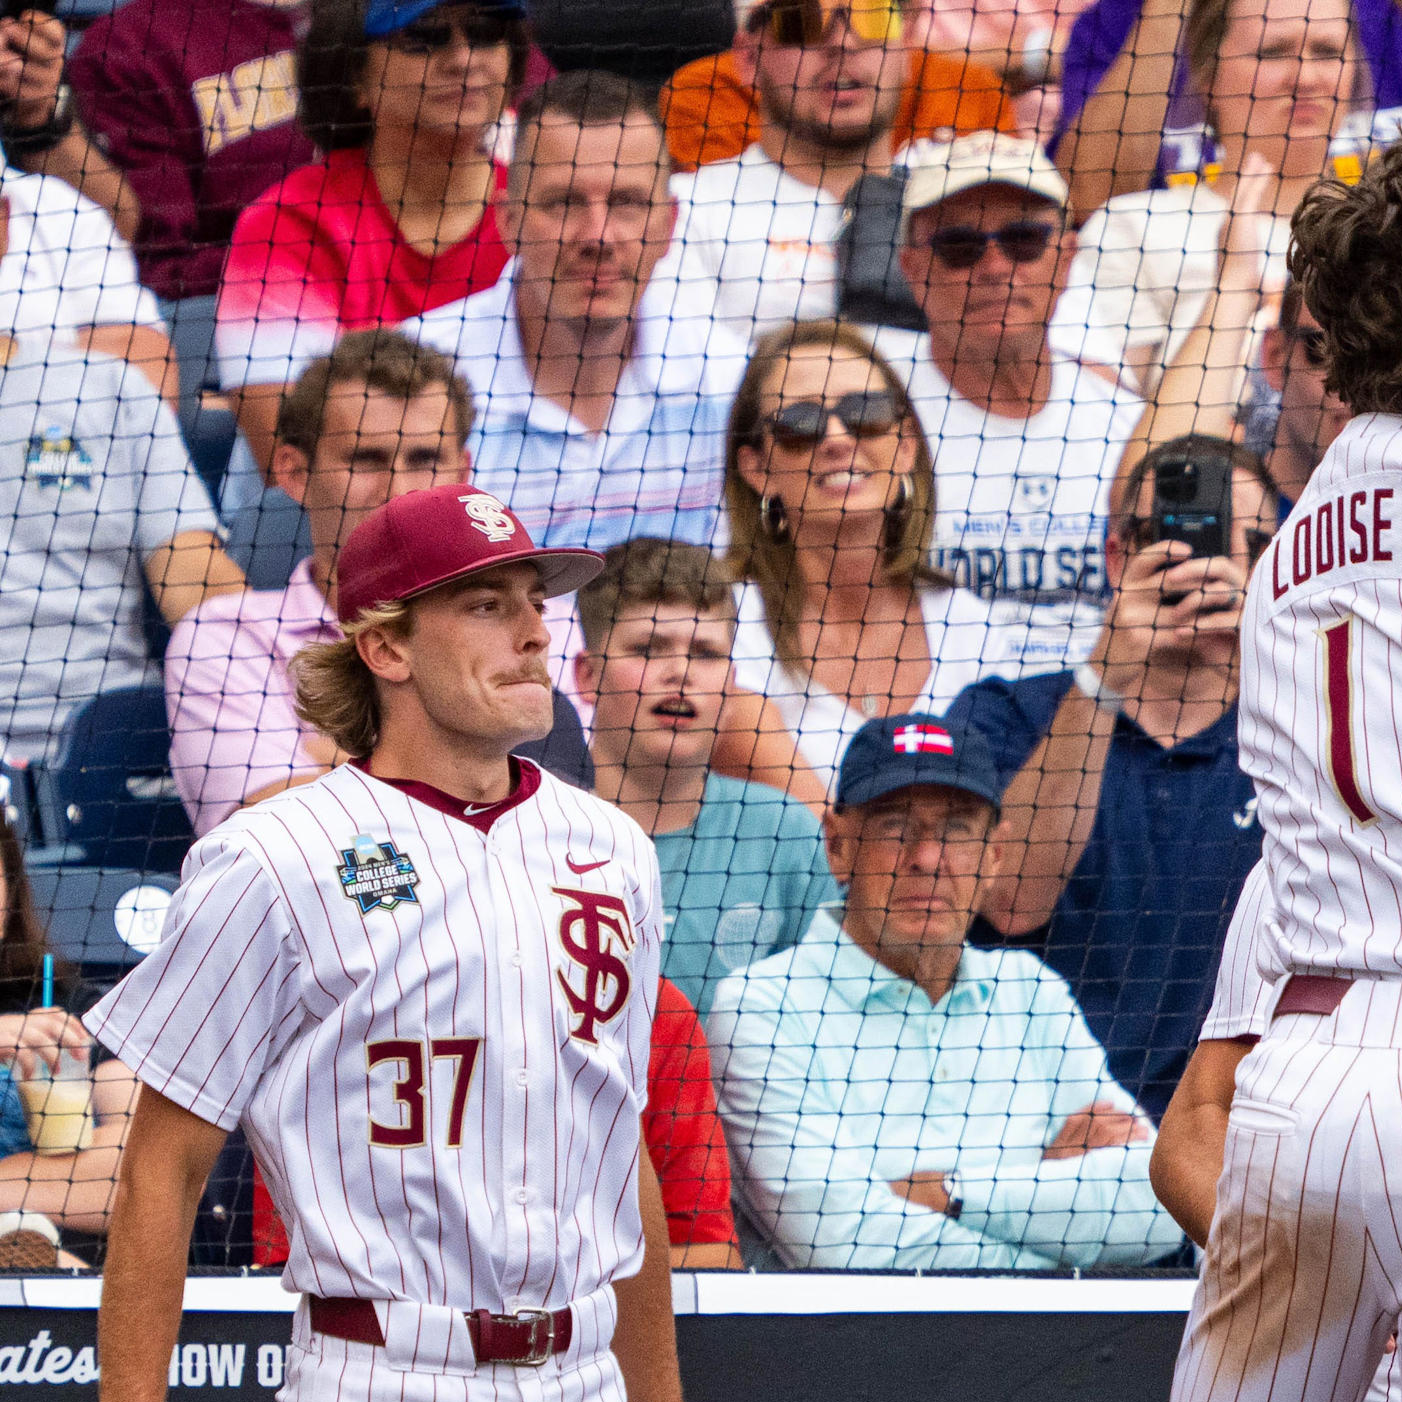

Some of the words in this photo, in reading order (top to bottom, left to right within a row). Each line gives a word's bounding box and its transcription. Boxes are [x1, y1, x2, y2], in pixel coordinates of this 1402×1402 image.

[1027, 515, 1108, 538] COLLE
[1272, 488, 1395, 602] LODISE
[1055, 546, 1112, 597] SE
[1313, 612, 1379, 829] 1
[345, 879, 382, 896] WORLD
[382, 872, 417, 889] SERIES
[356, 864, 399, 882] COLLEGE
[364, 1036, 488, 1149] 37
[0, 1330, 101, 1385] ates
[256, 1343, 289, 1388] O
